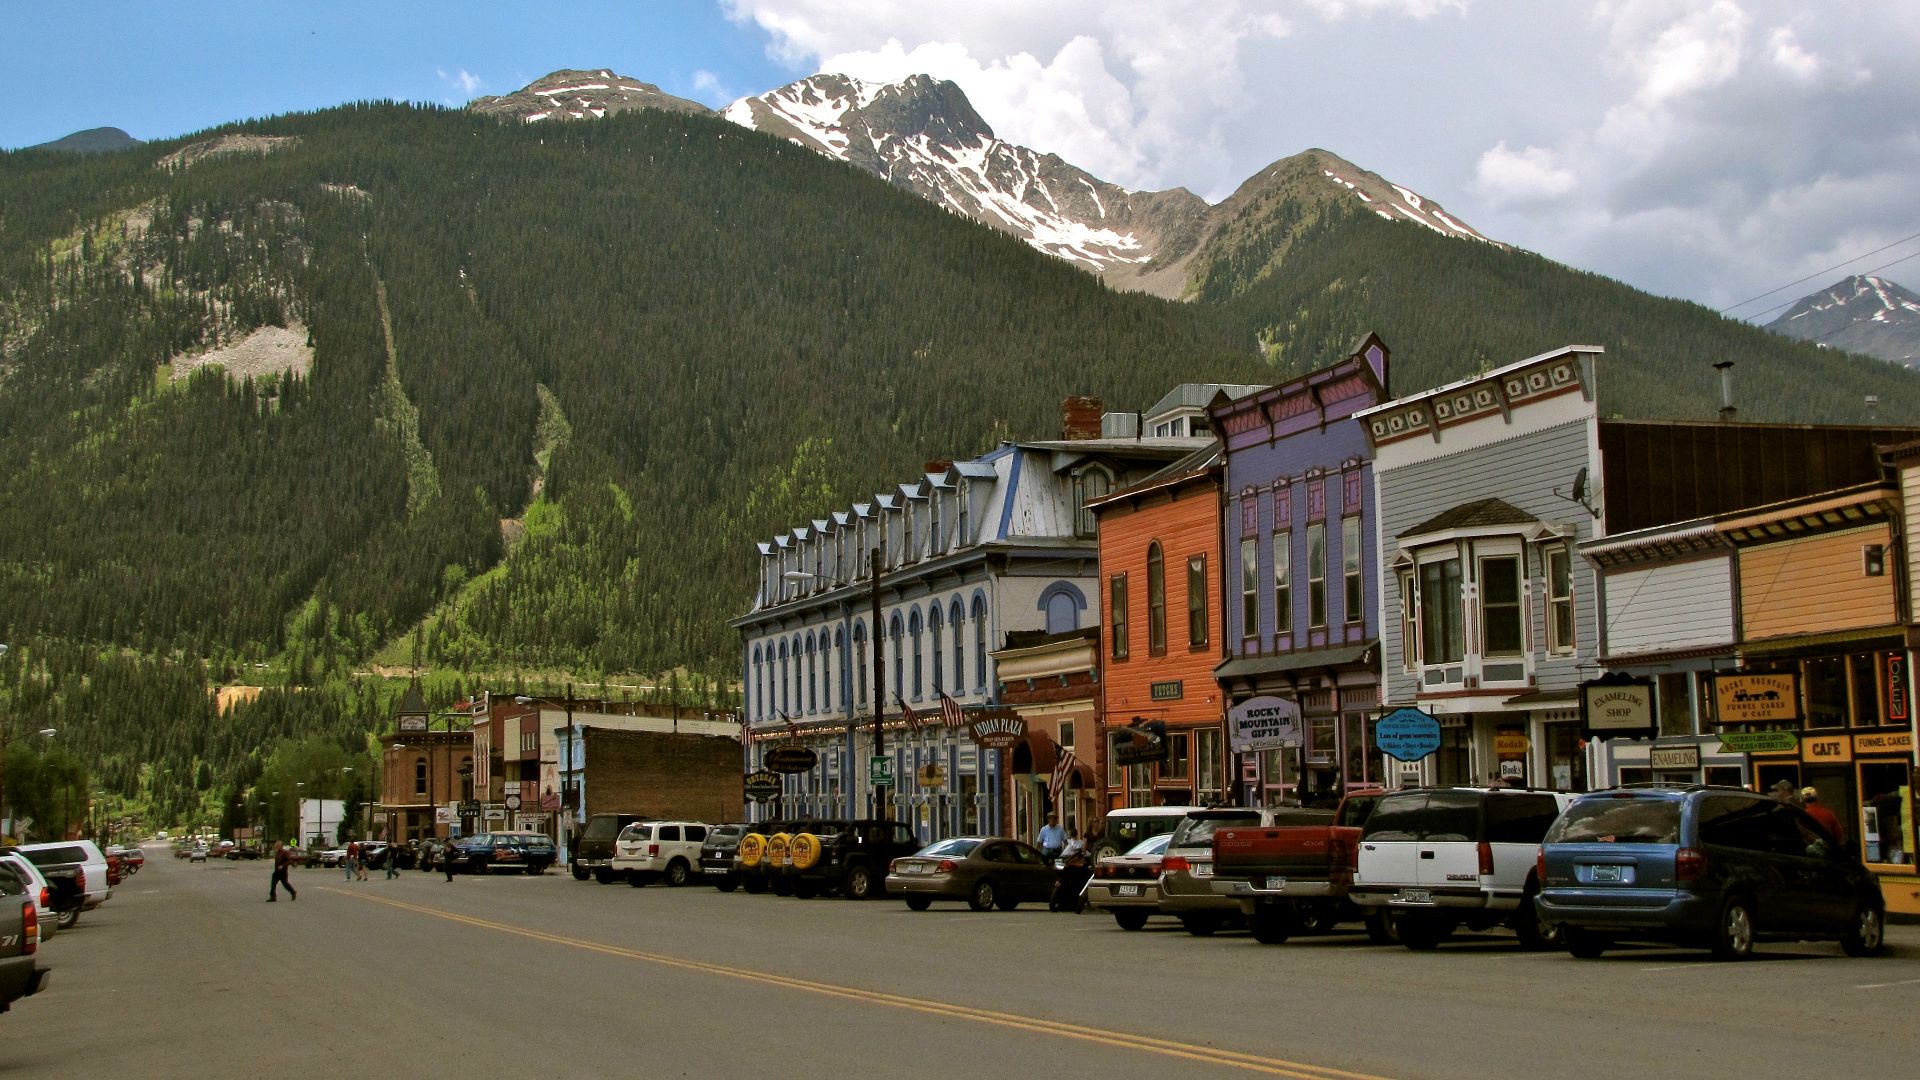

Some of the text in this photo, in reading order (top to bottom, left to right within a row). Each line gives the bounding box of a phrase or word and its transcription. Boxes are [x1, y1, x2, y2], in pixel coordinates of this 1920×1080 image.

[1719, 677, 1791, 694] ROCKY MOUNTAIN
[1890, 661, 1902, 715] OPEN
[1593, 692, 1643, 708] ENAMELING
[1247, 707, 1281, 718] ROCKY
[1606, 707, 1632, 717] SHOP
[1726, 703, 1756, 711] FUNNEL
[974, 718, 1023, 737] INDIAN PLAZA
[1239, 717, 1291, 729] MOUNTAIN
[1251, 728, 1280, 738] GIFTS
[1497, 740, 1524, 749] Kodak
[1858, 736, 1911, 747] FUNNEL CAKES
[1812, 742, 1841, 755] CAFE
[1653, 752, 1696, 765] ENAMELING
[1502, 764, 1522, 774] Books
